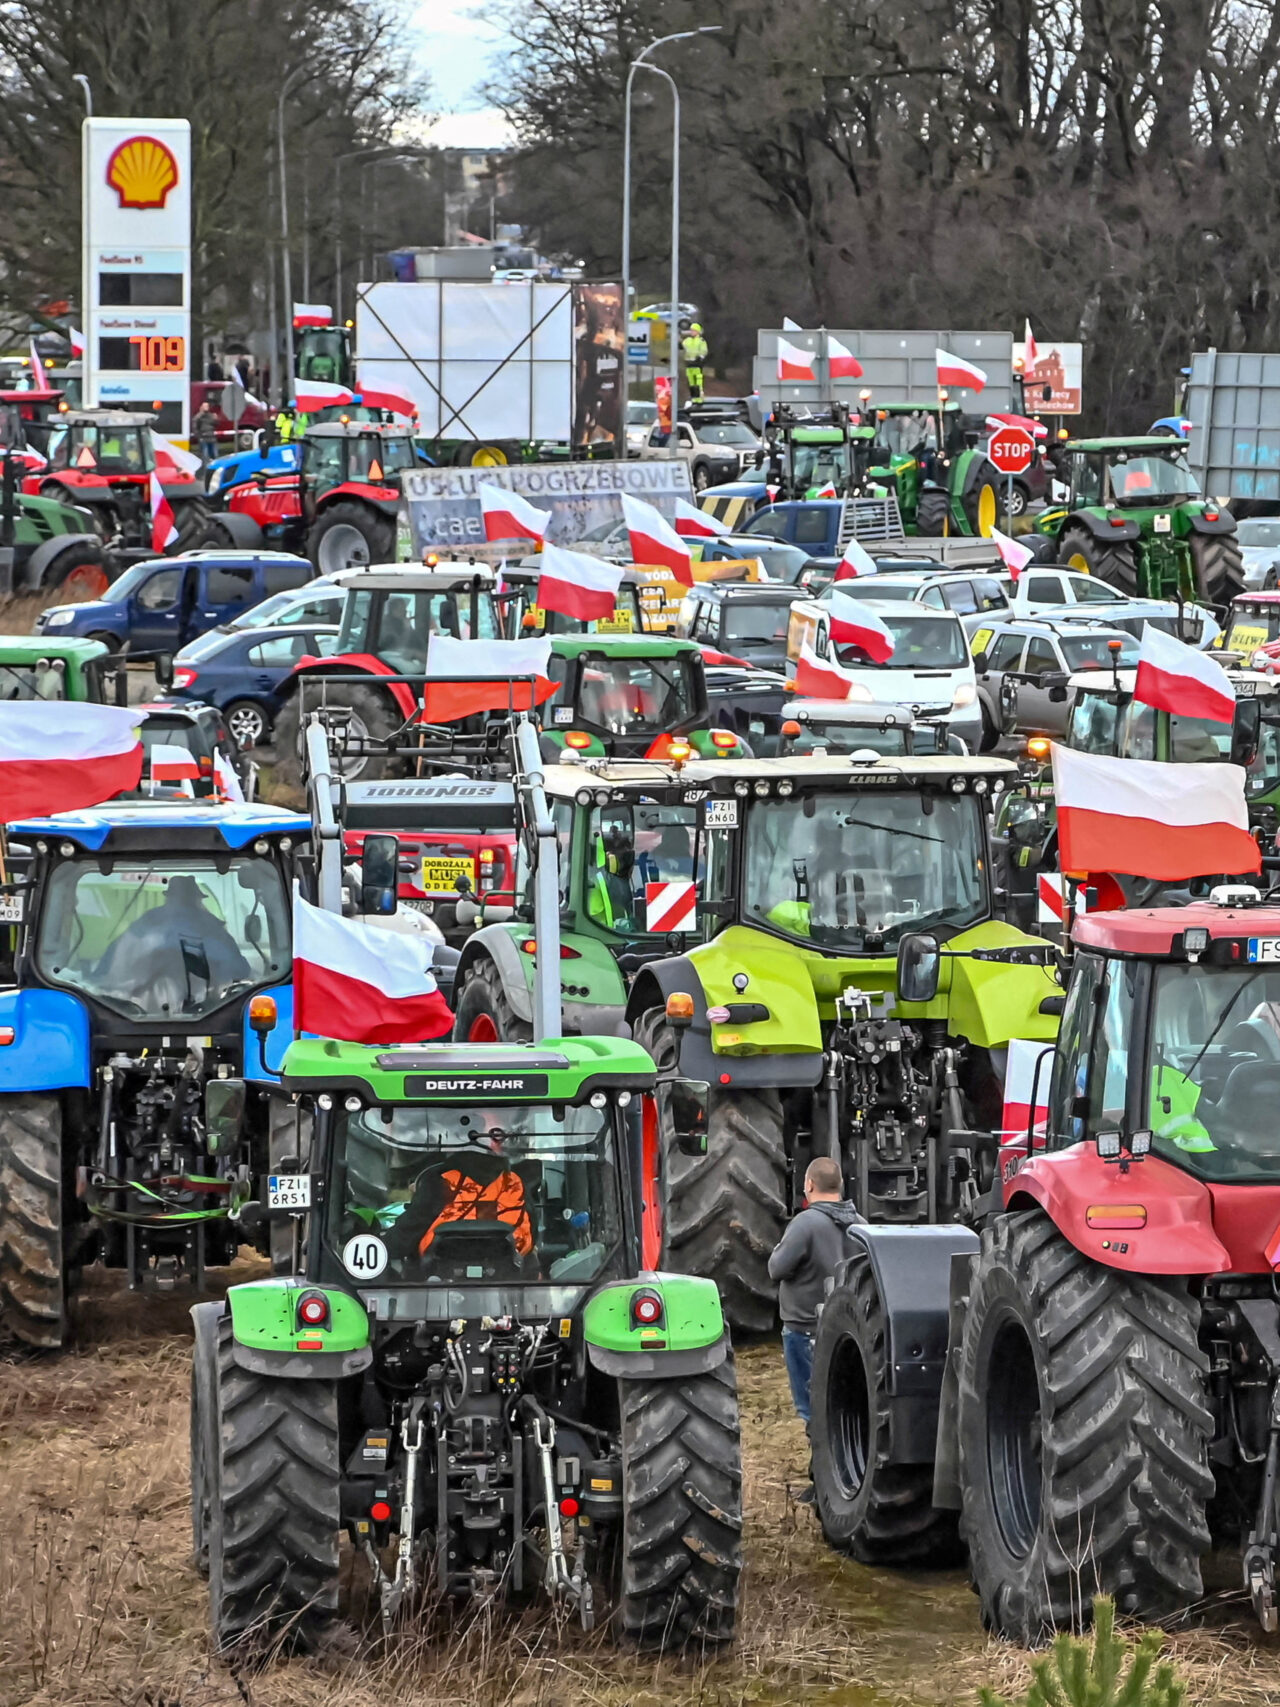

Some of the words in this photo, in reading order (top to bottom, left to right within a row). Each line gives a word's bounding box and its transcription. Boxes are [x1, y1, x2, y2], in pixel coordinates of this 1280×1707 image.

[993, 443, 1031, 457] STOP
[510, 468, 686, 494] POGRZEBOWE
[848, 775, 898, 784] CLAAS
[713, 802, 731, 811] FZI
[708, 813, 735, 822] 6N60
[424, 882, 458, 890] ODEJ
[425, 1080, 524, 1090] DEUTZ-FAHR
[278, 1179, 302, 1191] FZI
[272, 1193, 307, 1205] 6R51
[352, 1243, 379, 1271] 40
